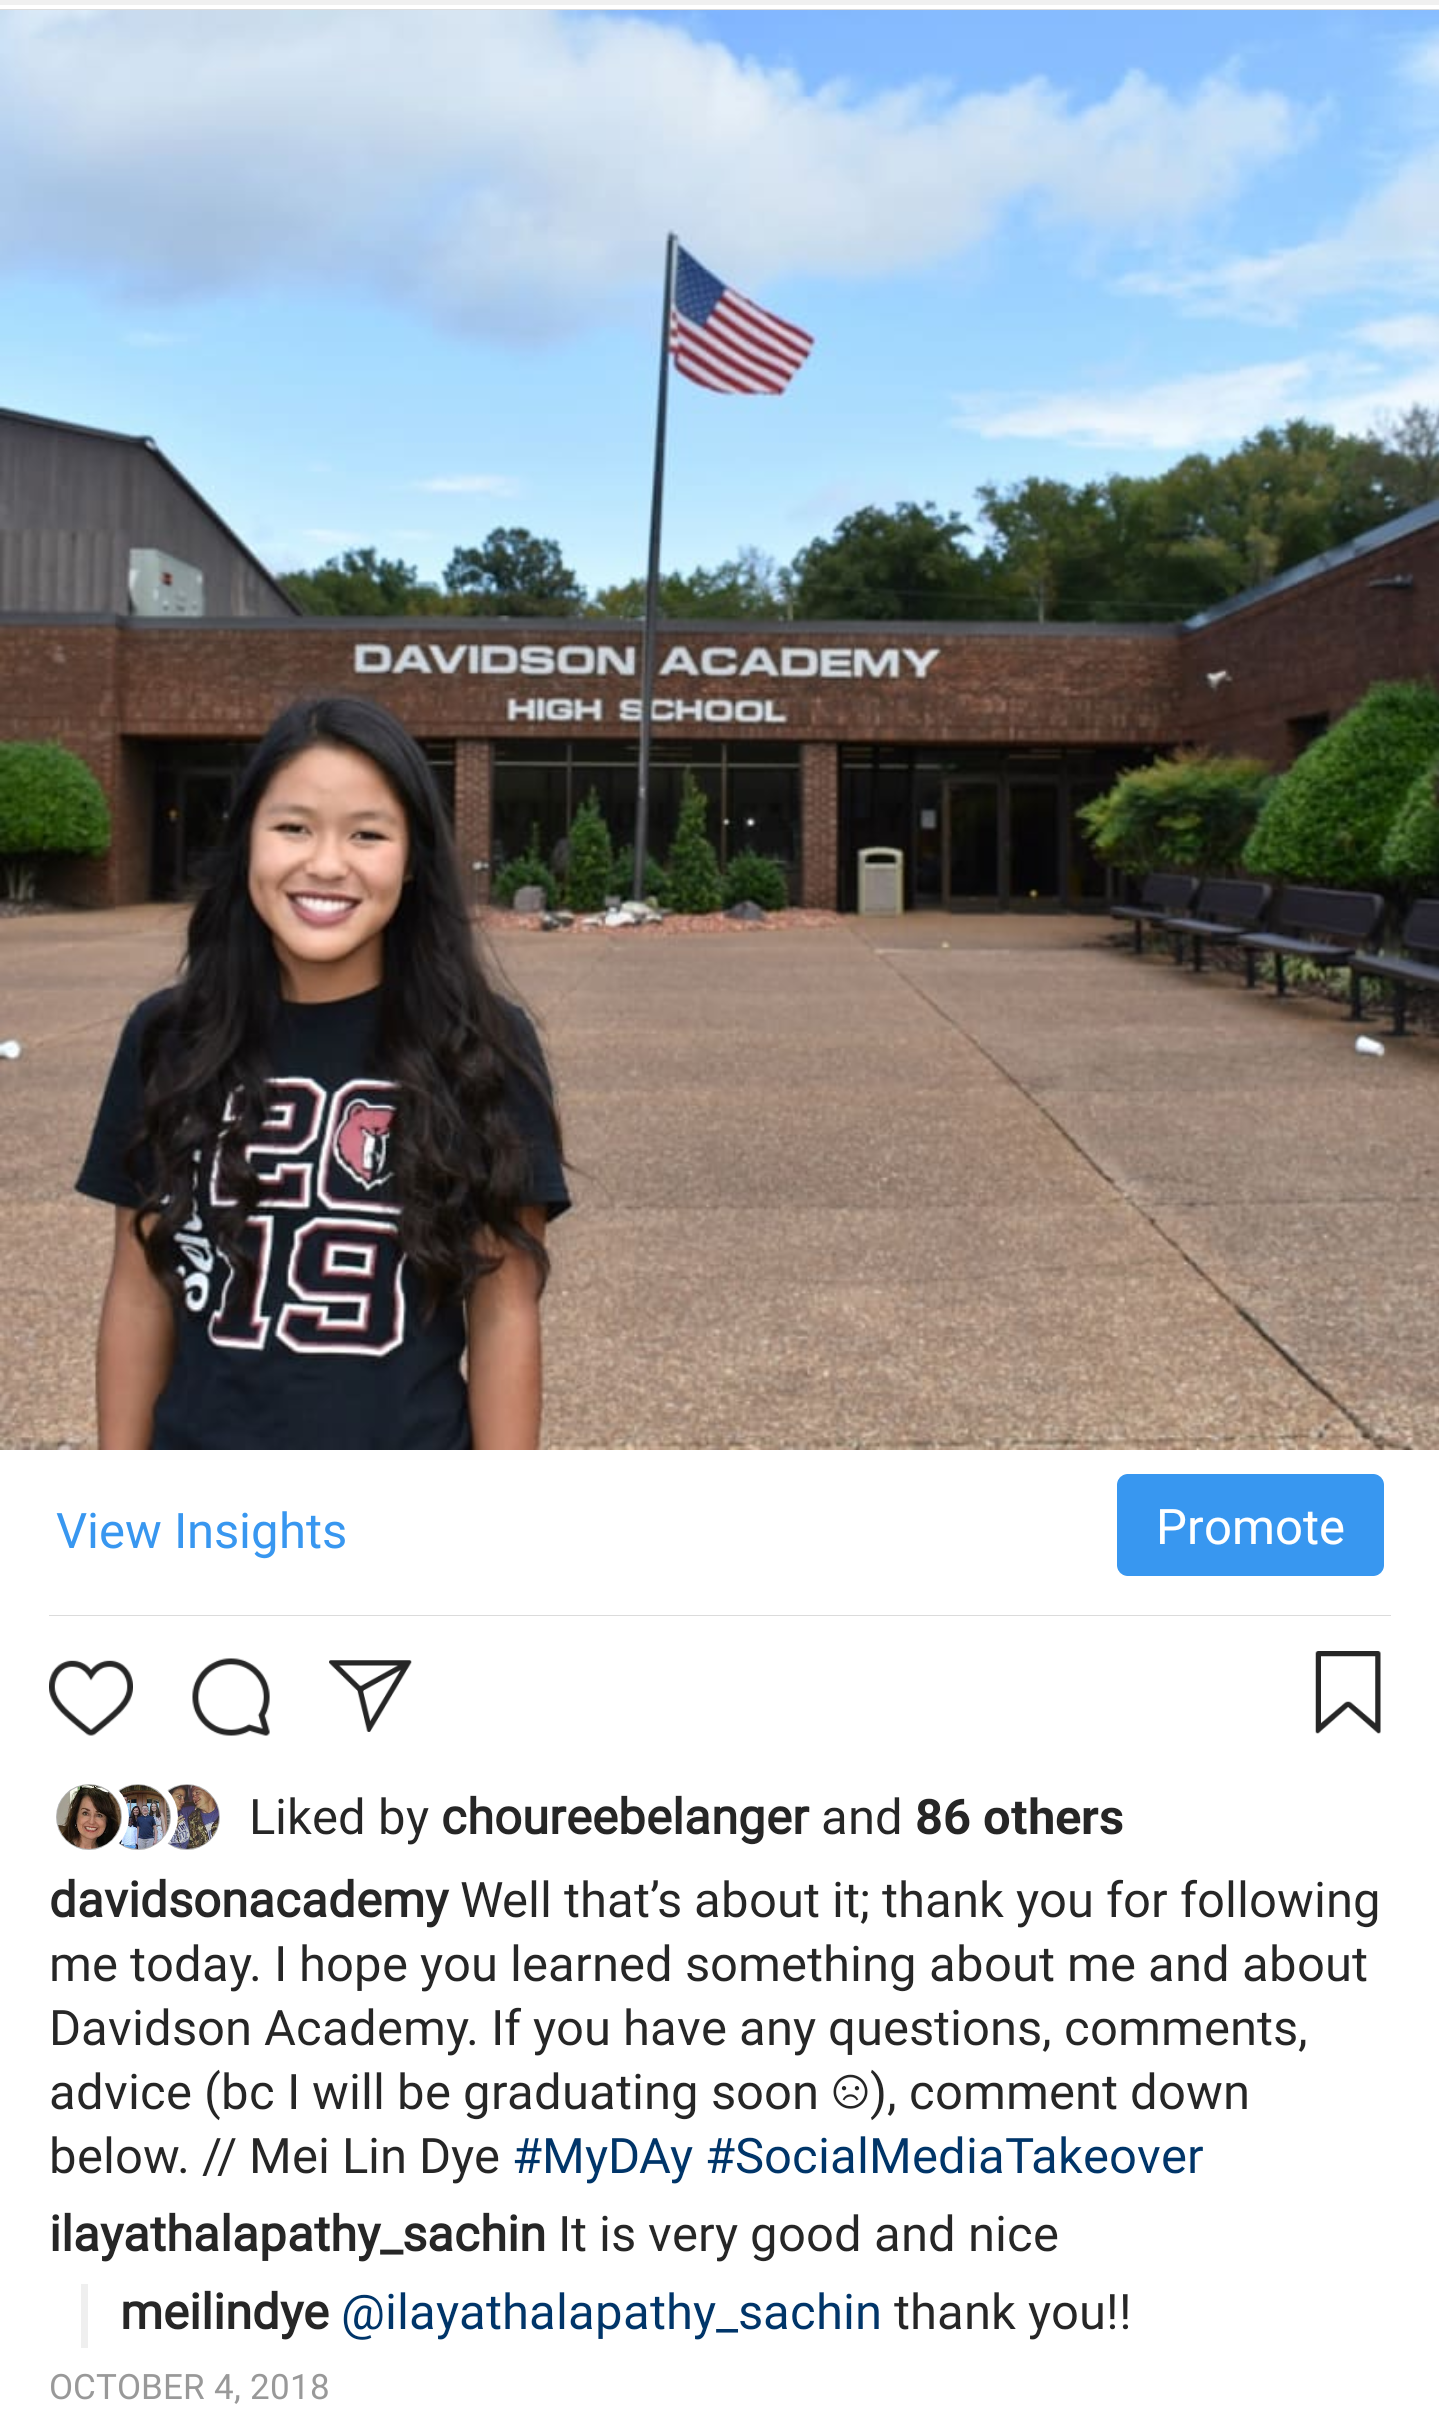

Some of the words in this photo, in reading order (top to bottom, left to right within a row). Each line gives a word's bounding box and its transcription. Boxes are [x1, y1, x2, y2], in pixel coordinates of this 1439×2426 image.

[354, 644, 636, 676] DAVIDSON
[658, 646, 941, 679] ACADEMY
[507, 697, 602, 722] HIGH
[619, 698, 787, 723] SCHOOL
[208, 1215, 407, 1357] 19
